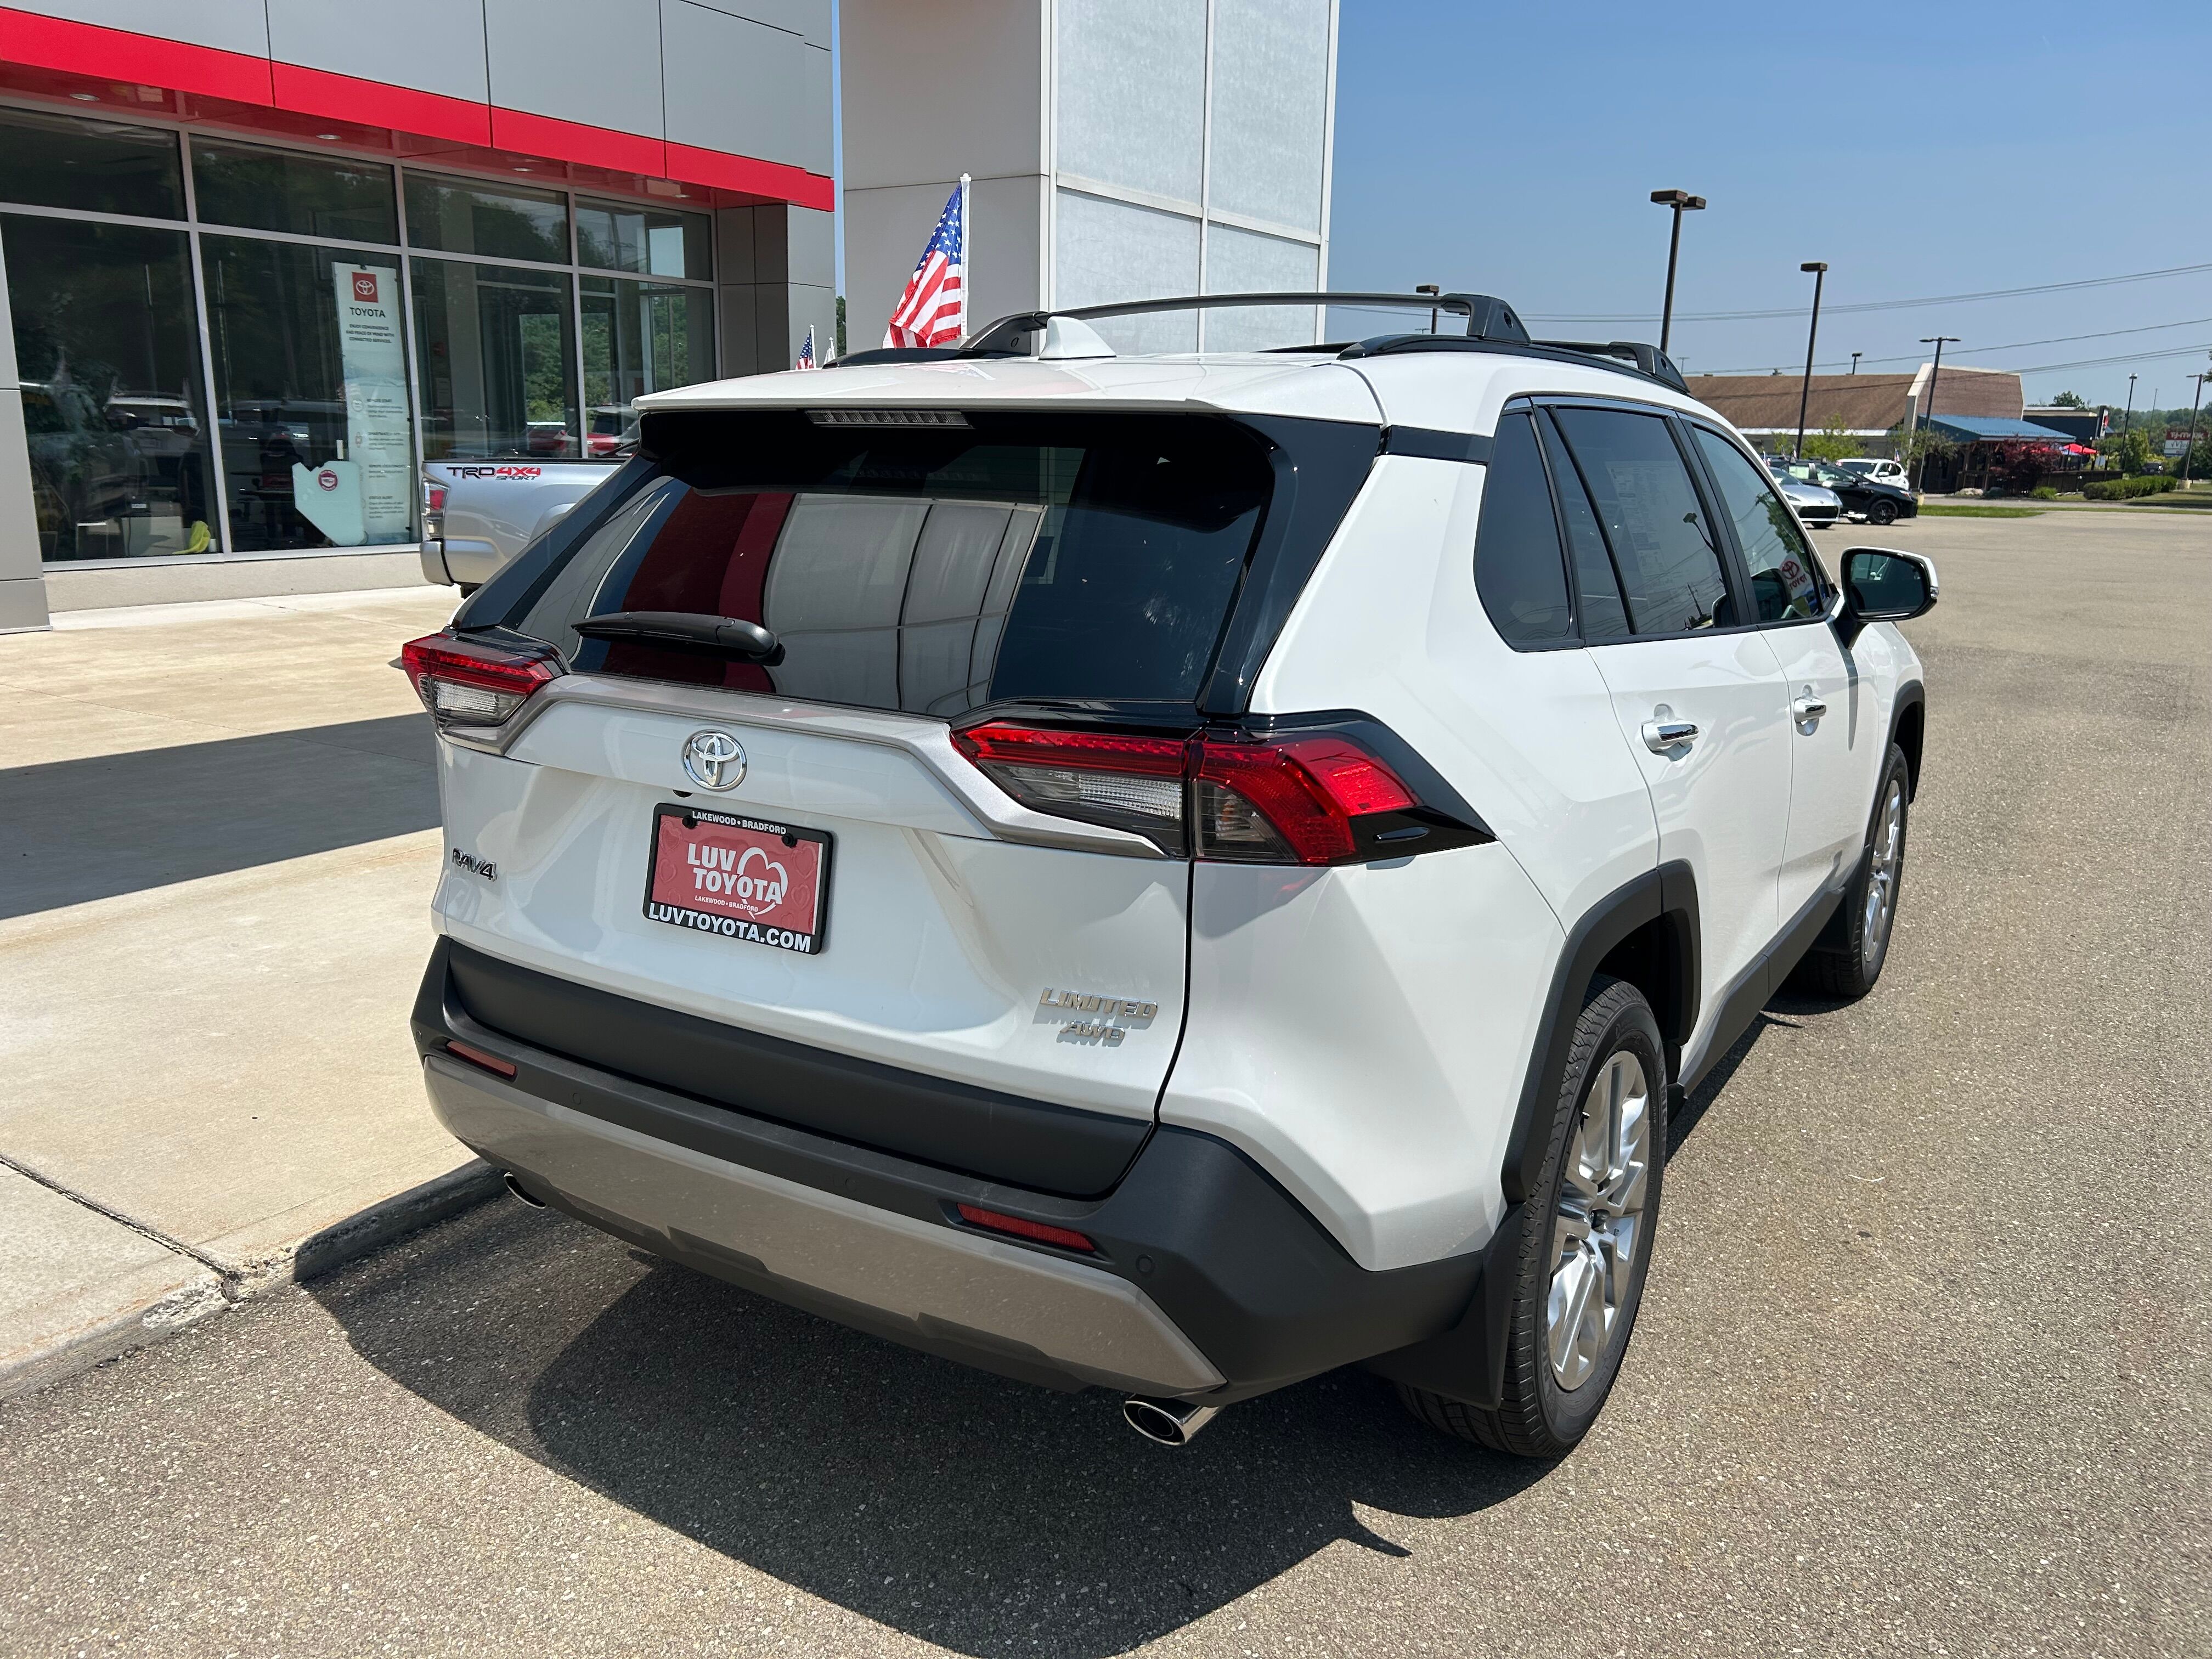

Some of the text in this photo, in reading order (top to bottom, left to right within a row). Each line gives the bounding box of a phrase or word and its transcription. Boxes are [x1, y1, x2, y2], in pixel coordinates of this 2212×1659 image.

[349, 307, 386, 318] TOYOTA
[446, 467, 495, 479] TRD
[692, 810, 787, 835] LAKEWOOD BRADFORD
[452, 847, 498, 882] RAV4
[687, 843, 737, 872] LUV
[693, 868, 782, 905] TOYOTA
[695, 895, 759, 912] LAKEWOOD BRADFORD
[648, 903, 811, 953] LUVTOYOTA.COM
[1040, 986, 1159, 1019] LIMITED
[1059, 1020, 1125, 1041] AWD
